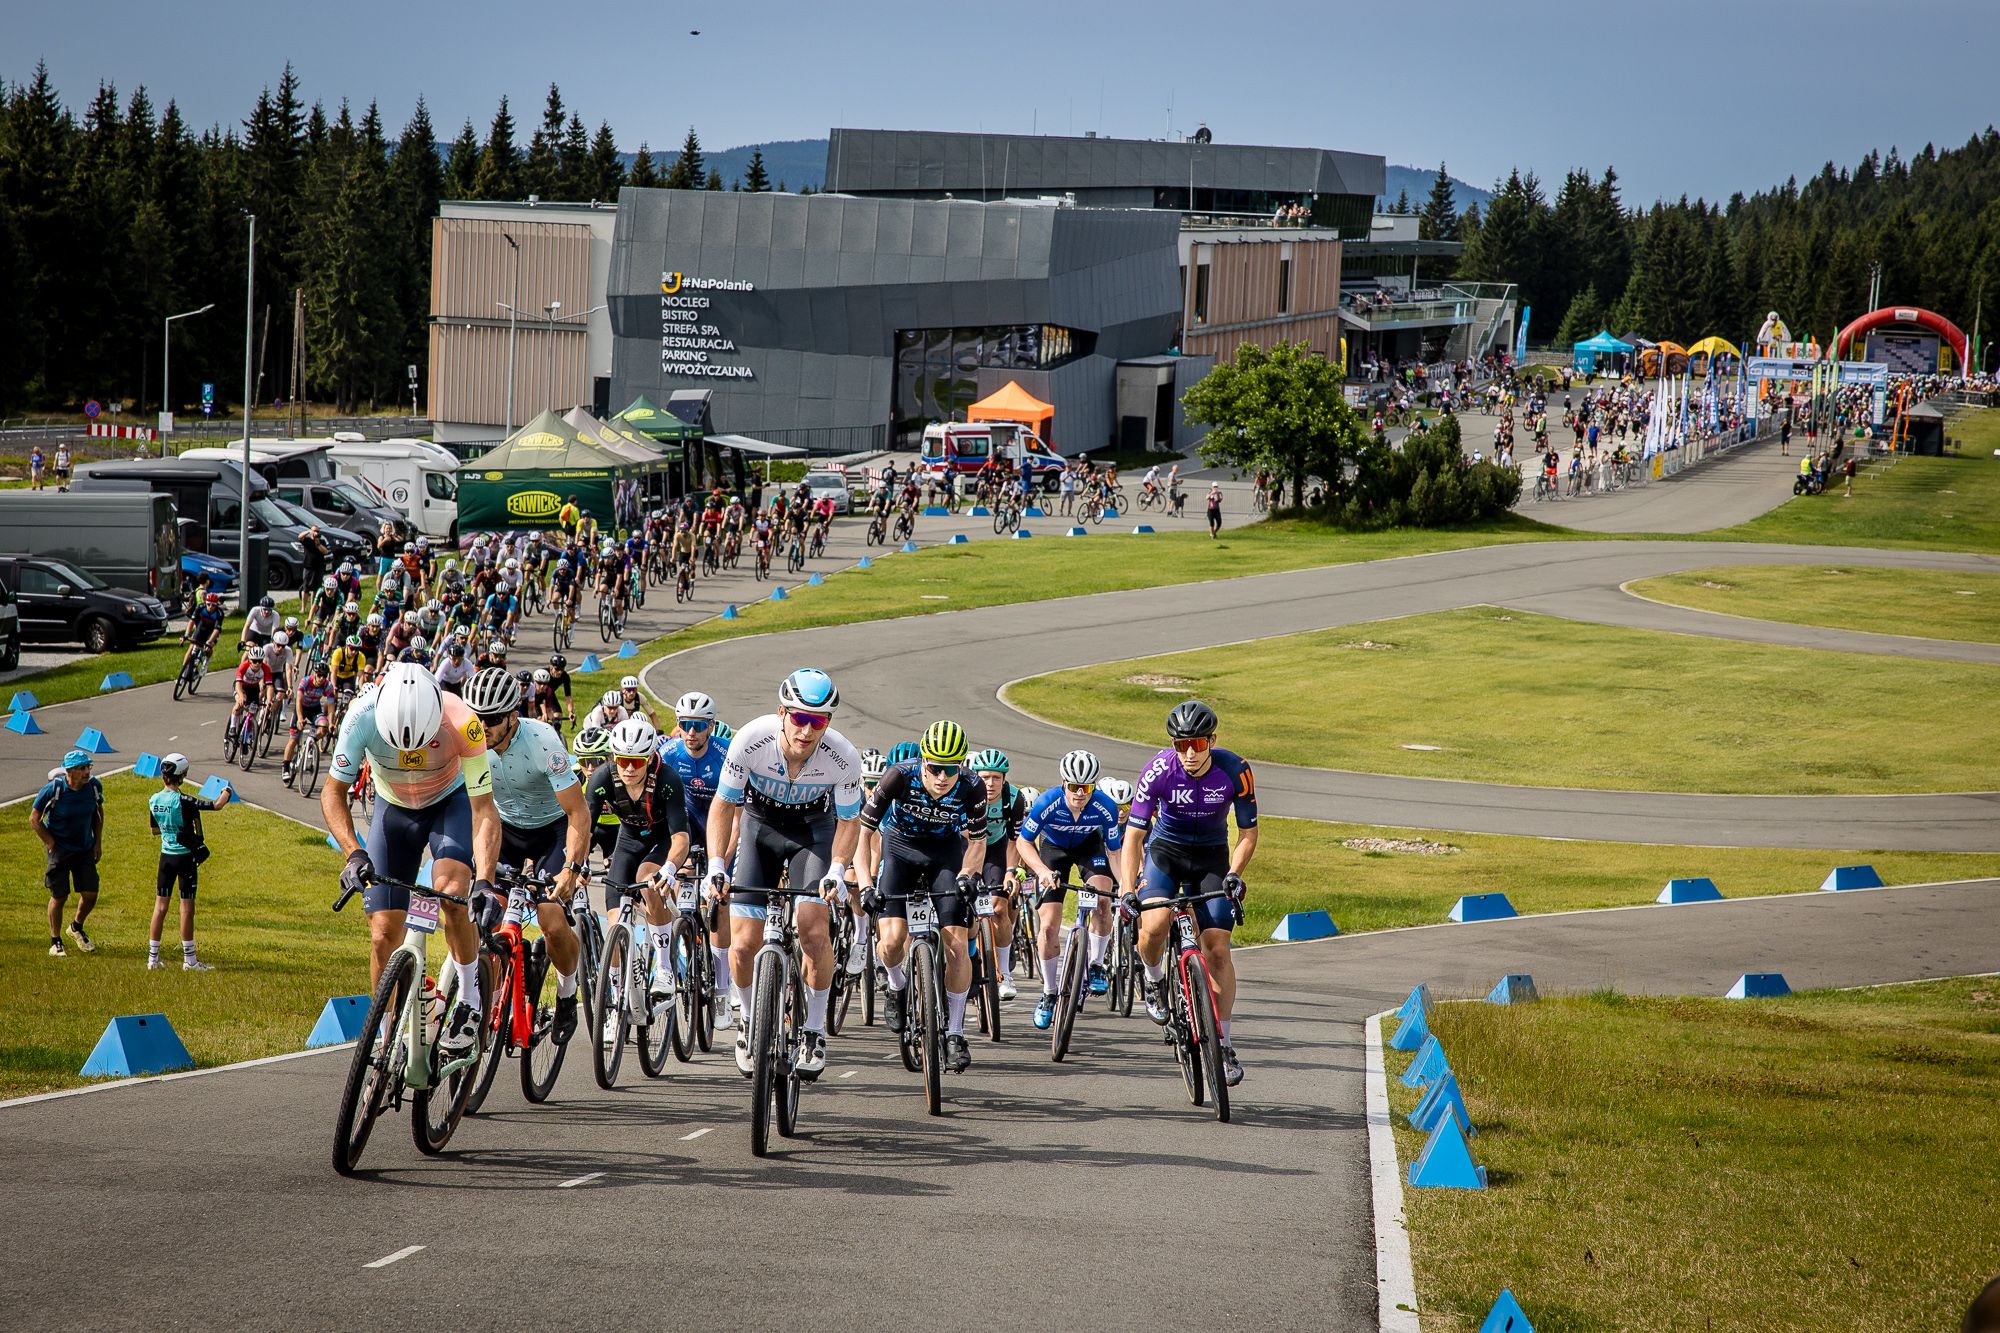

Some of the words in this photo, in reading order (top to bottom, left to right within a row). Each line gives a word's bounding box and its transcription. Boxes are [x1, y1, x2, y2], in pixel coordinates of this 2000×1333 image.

[681, 278, 754, 291] #NaPolanie
[661, 297, 710, 308] NOCLEGI
[661, 309, 698, 321] BISTRO
[662, 323, 699, 335] STREFA
[701, 325, 720, 336] SPA
[662, 336, 735, 350] RESTAURACJA
[662, 349, 708, 362] PARKING
[662, 362, 753, 377] WYPOŻYCZALNIA
[507, 494, 562, 513] FENWICK'S
[745, 734, 776, 755] CANYON
[820, 742, 832, 753] DT
[829, 750, 849, 771] SWISS
[1135, 757, 1170, 803] quest
[756, 776, 828, 802] EMBRACE
[901, 803, 960, 820] metec
[1040, 796, 1062, 820] GIANT
[1092, 801, 1113, 822] GIANT
[680, 891, 692, 900] 47
[978, 899, 990, 907] 88
[410, 898, 439, 916] 202
[911, 910, 927, 921] 46
